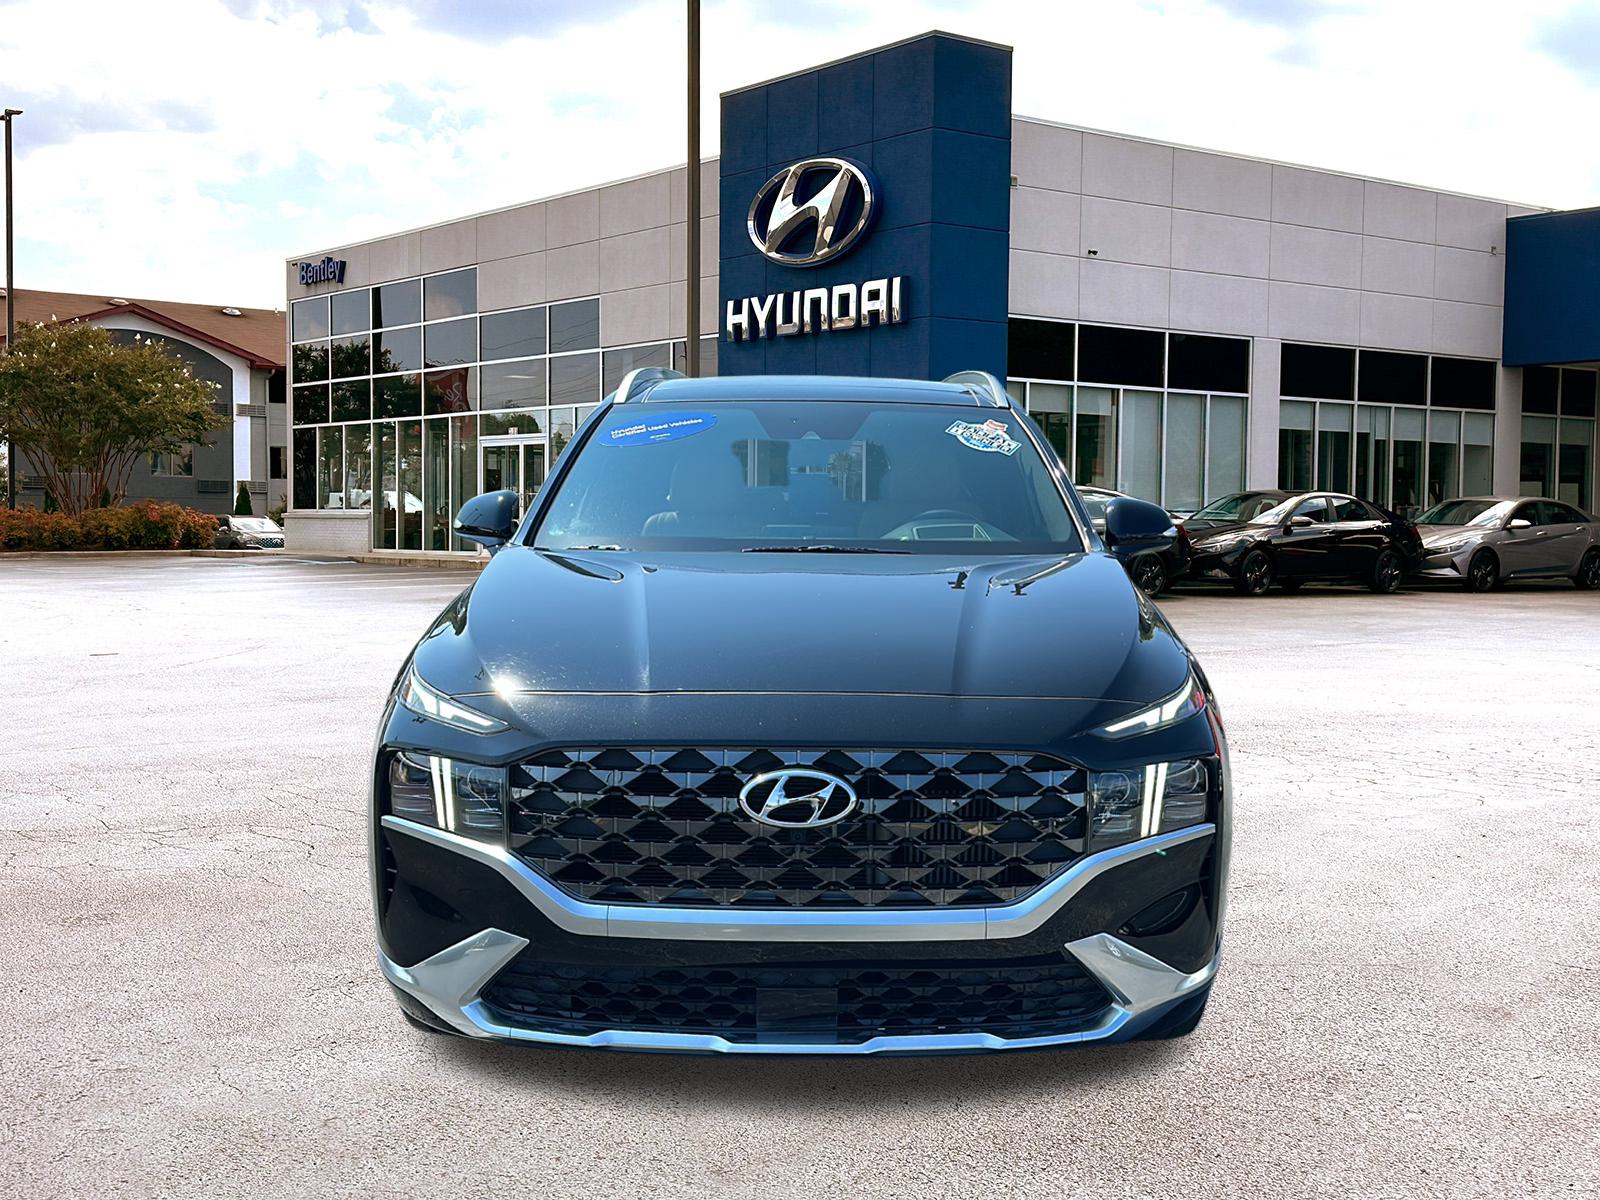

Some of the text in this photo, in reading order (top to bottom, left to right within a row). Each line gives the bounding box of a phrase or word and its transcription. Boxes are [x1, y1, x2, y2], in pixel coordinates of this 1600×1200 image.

[299, 256, 346, 286] Bentley
[726, 276, 902, 342] HYUNDAI
[648, 423, 669, 432] Used
